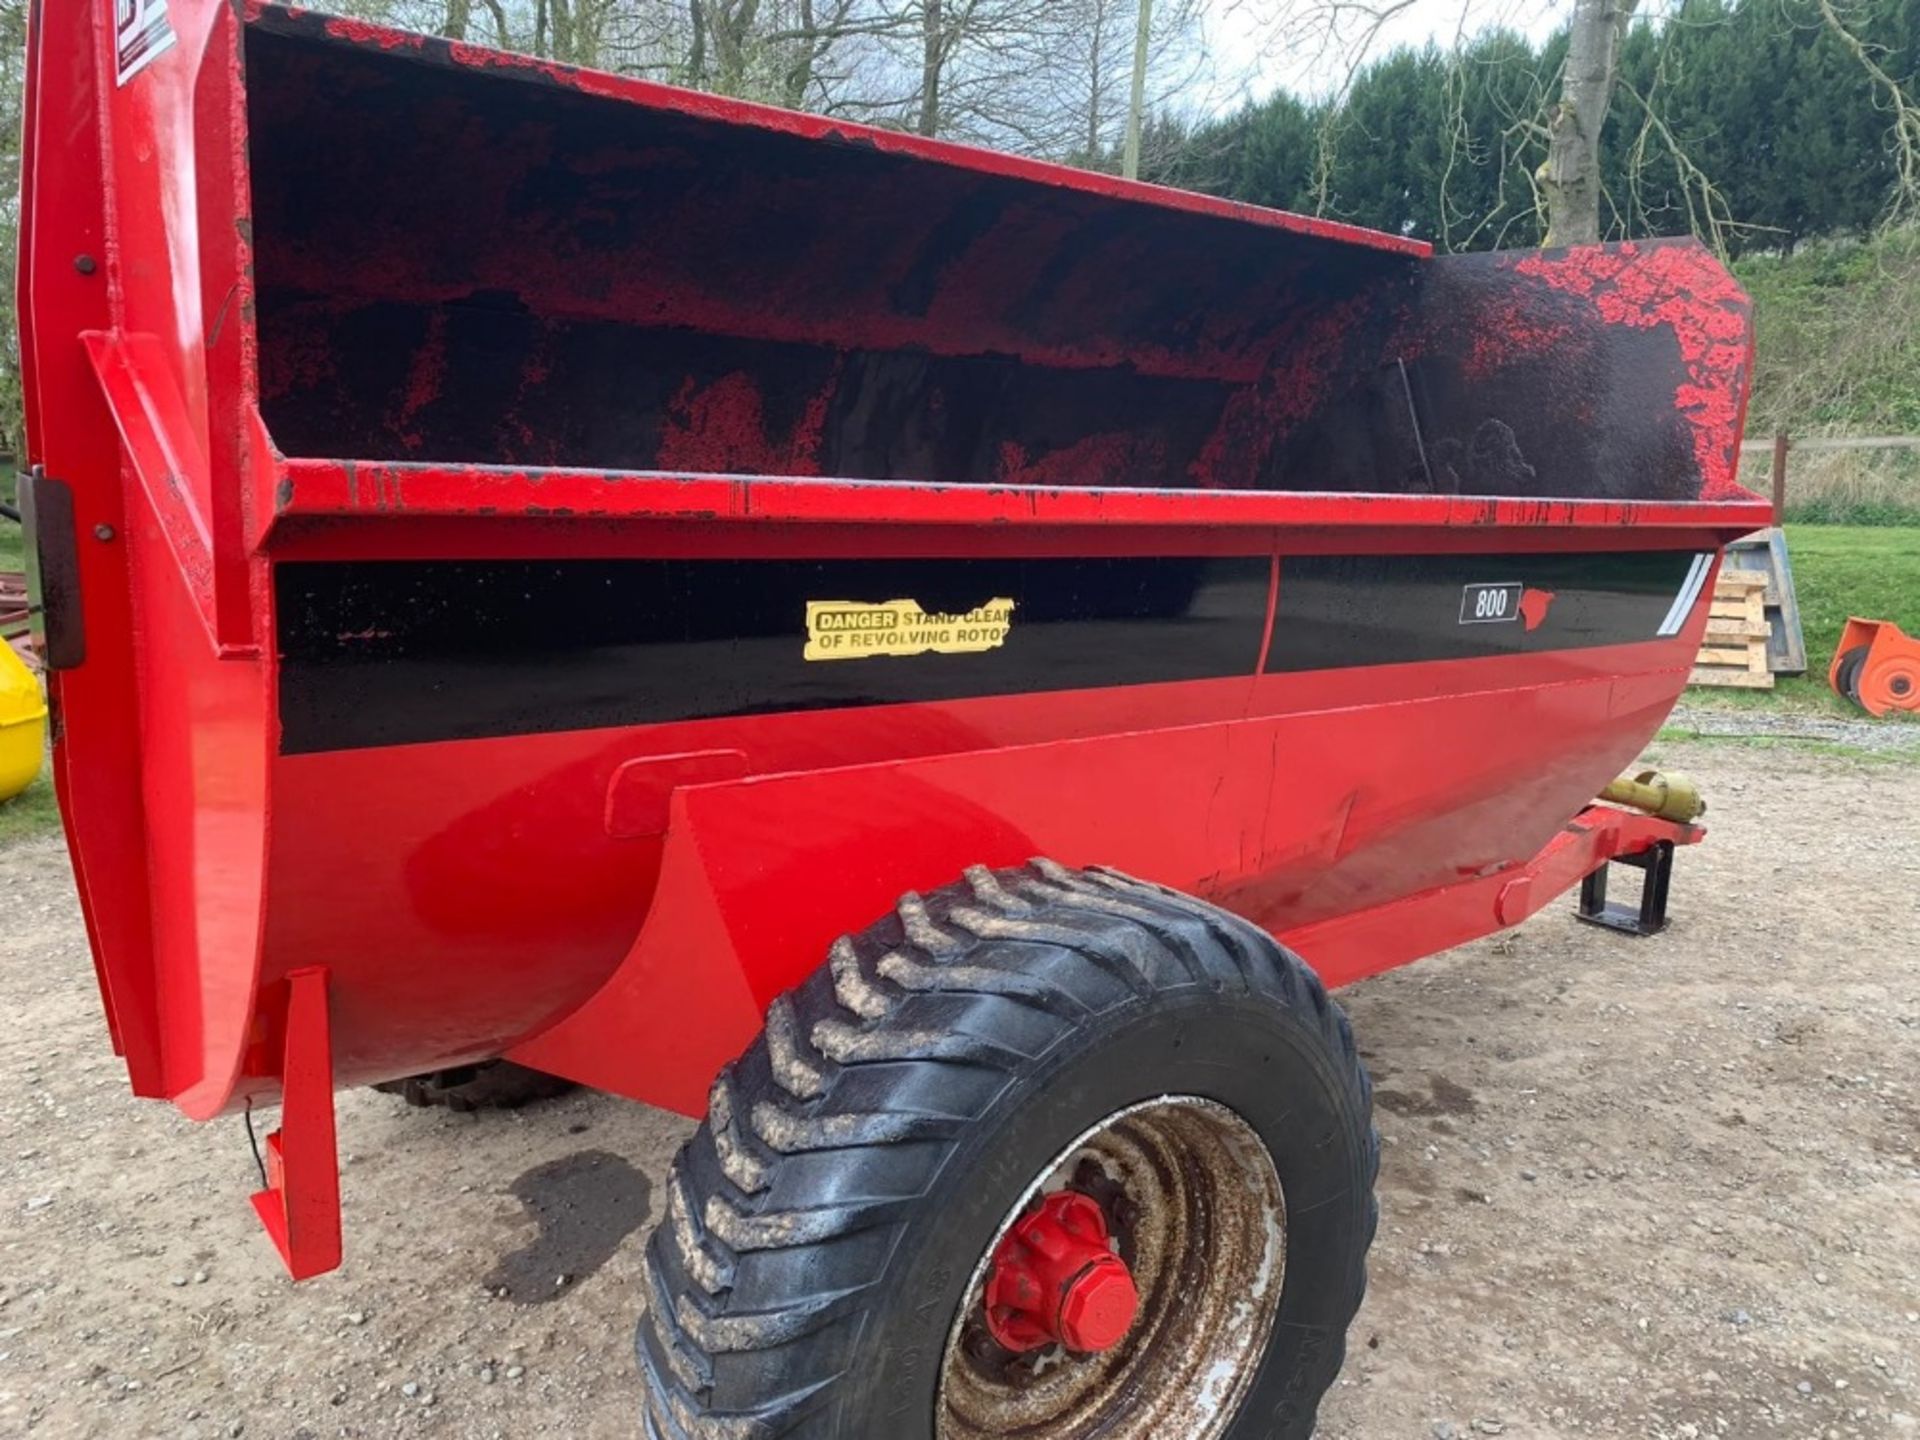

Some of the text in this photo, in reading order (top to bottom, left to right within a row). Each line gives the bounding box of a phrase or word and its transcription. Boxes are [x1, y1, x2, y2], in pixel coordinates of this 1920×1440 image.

[1476, 589, 1507, 617] 800
[818, 611, 895, 629] DANGER
[903, 611, 957, 625] STAND
[819, 627, 1008, 649] OF REVOLVING ROTO
